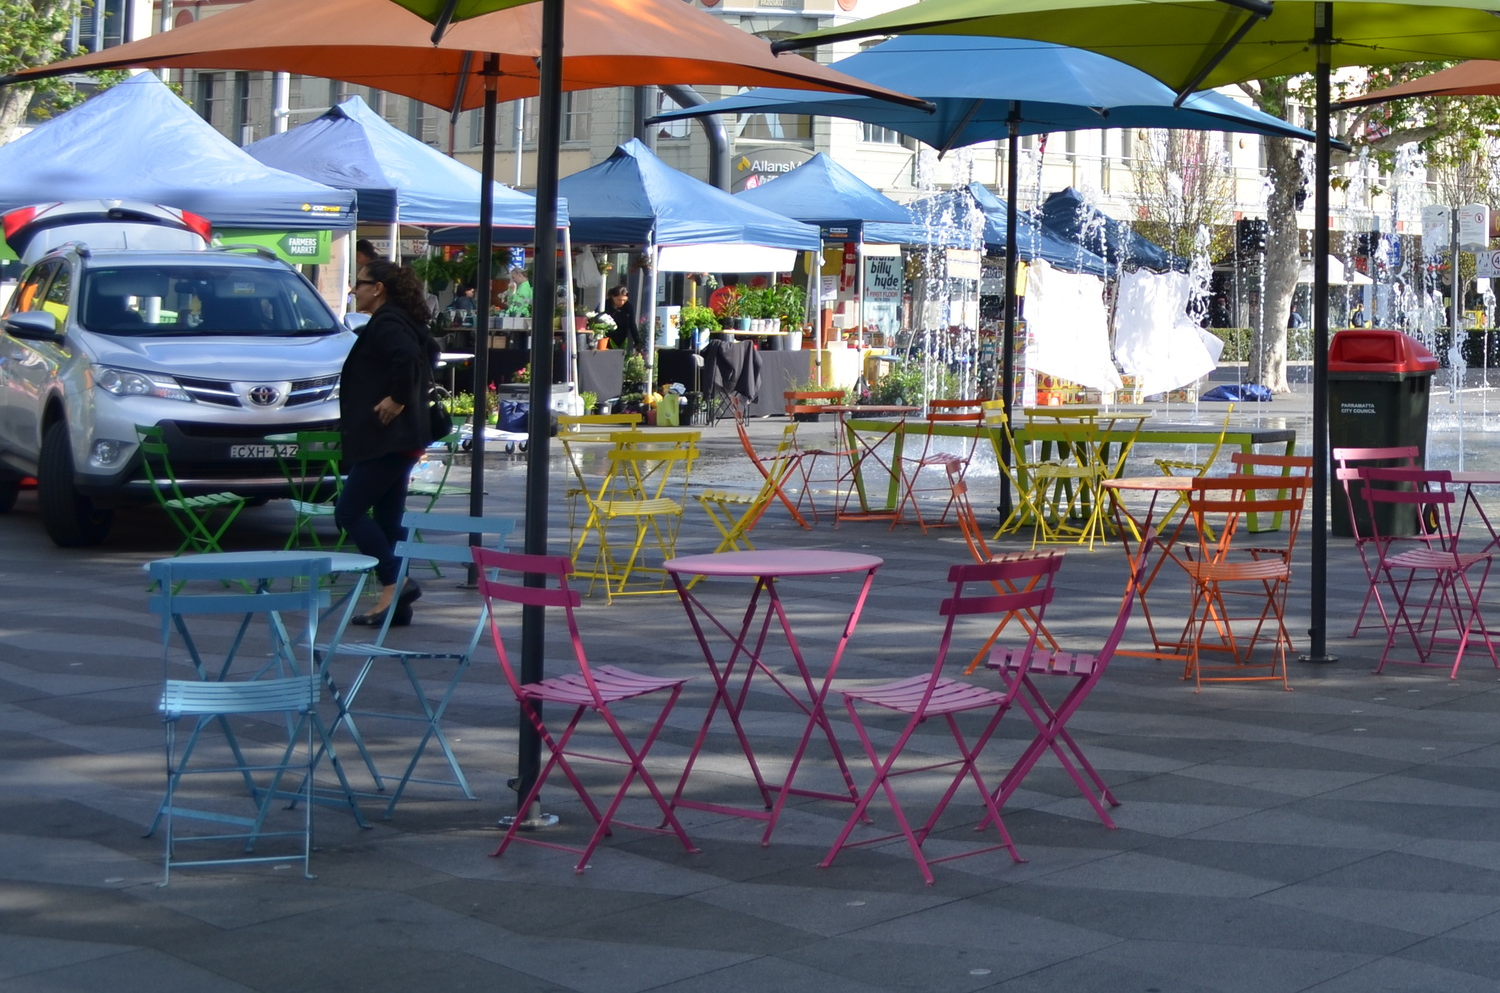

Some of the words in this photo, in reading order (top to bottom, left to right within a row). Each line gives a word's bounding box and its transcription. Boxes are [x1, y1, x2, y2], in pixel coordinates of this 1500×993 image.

[288, 237, 317, 247] FARMERS
[290, 246, 317, 255] MARKET
[870, 261, 892, 277] billy
[874, 274, 899, 290] hyde
